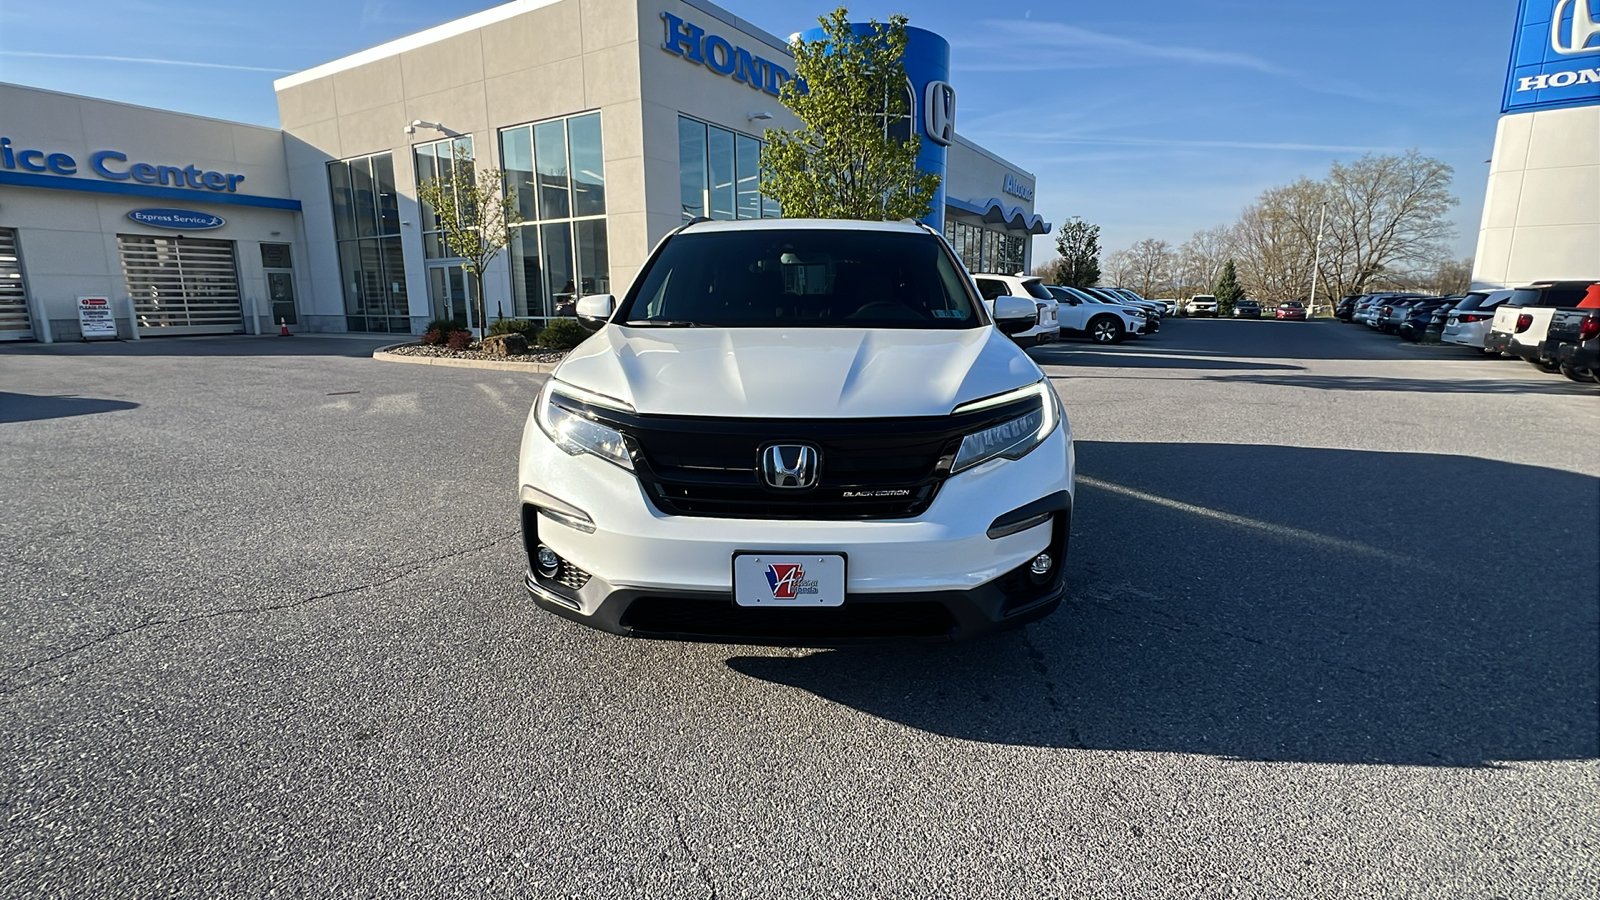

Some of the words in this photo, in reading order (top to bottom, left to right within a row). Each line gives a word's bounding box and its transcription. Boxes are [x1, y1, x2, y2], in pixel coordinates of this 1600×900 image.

[91, 150, 245, 192] Center
[135, 212, 172, 222] Express
[173, 215, 207, 224] Service
[875, 489, 910, 497] EDITION
